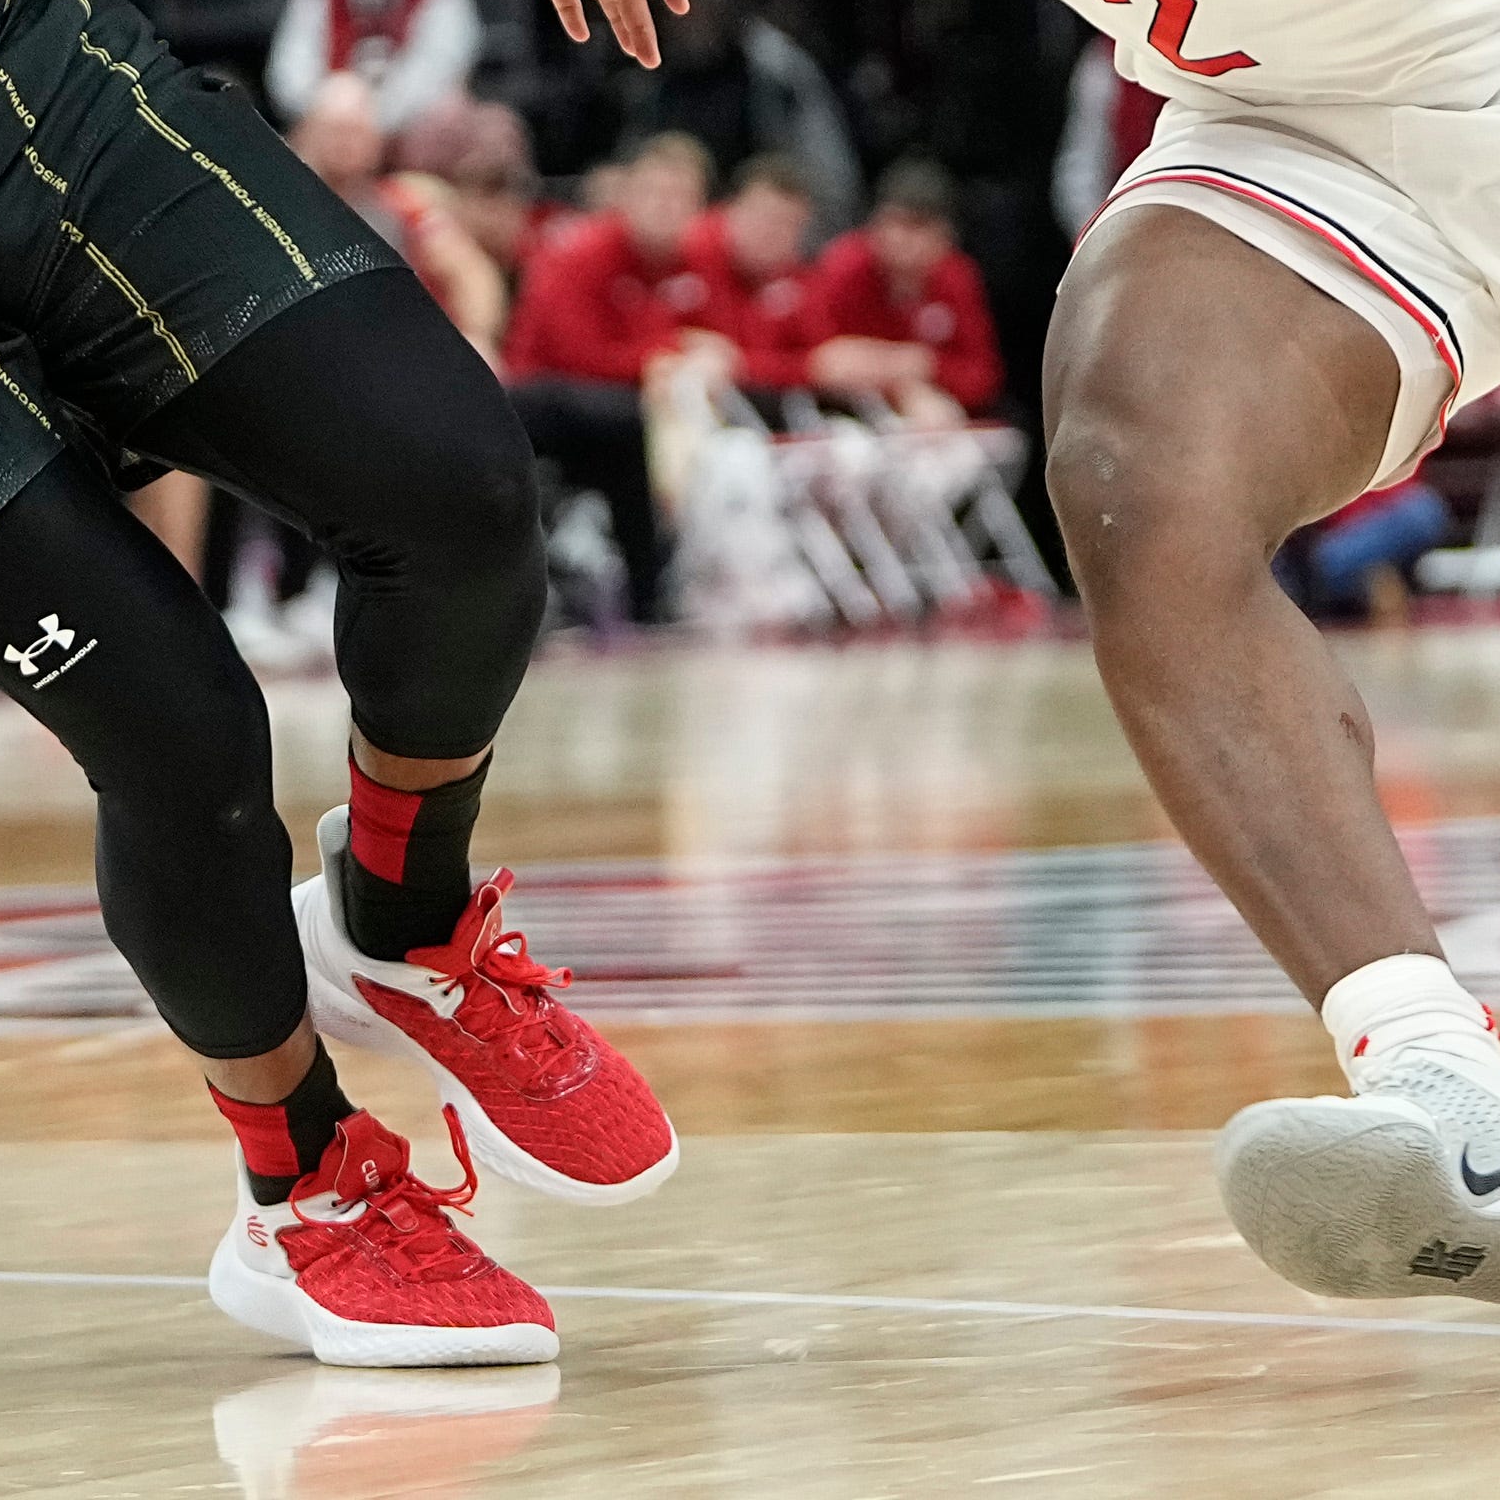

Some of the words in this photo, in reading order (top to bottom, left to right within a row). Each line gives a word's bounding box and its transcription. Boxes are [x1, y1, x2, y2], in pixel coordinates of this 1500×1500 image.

[191, 151, 257, 207] FORWARD
[252, 206, 316, 281] WISCONSIN
[32, 669, 60, 689] UNDER
[60, 638, 98, 673] ARMOUR
